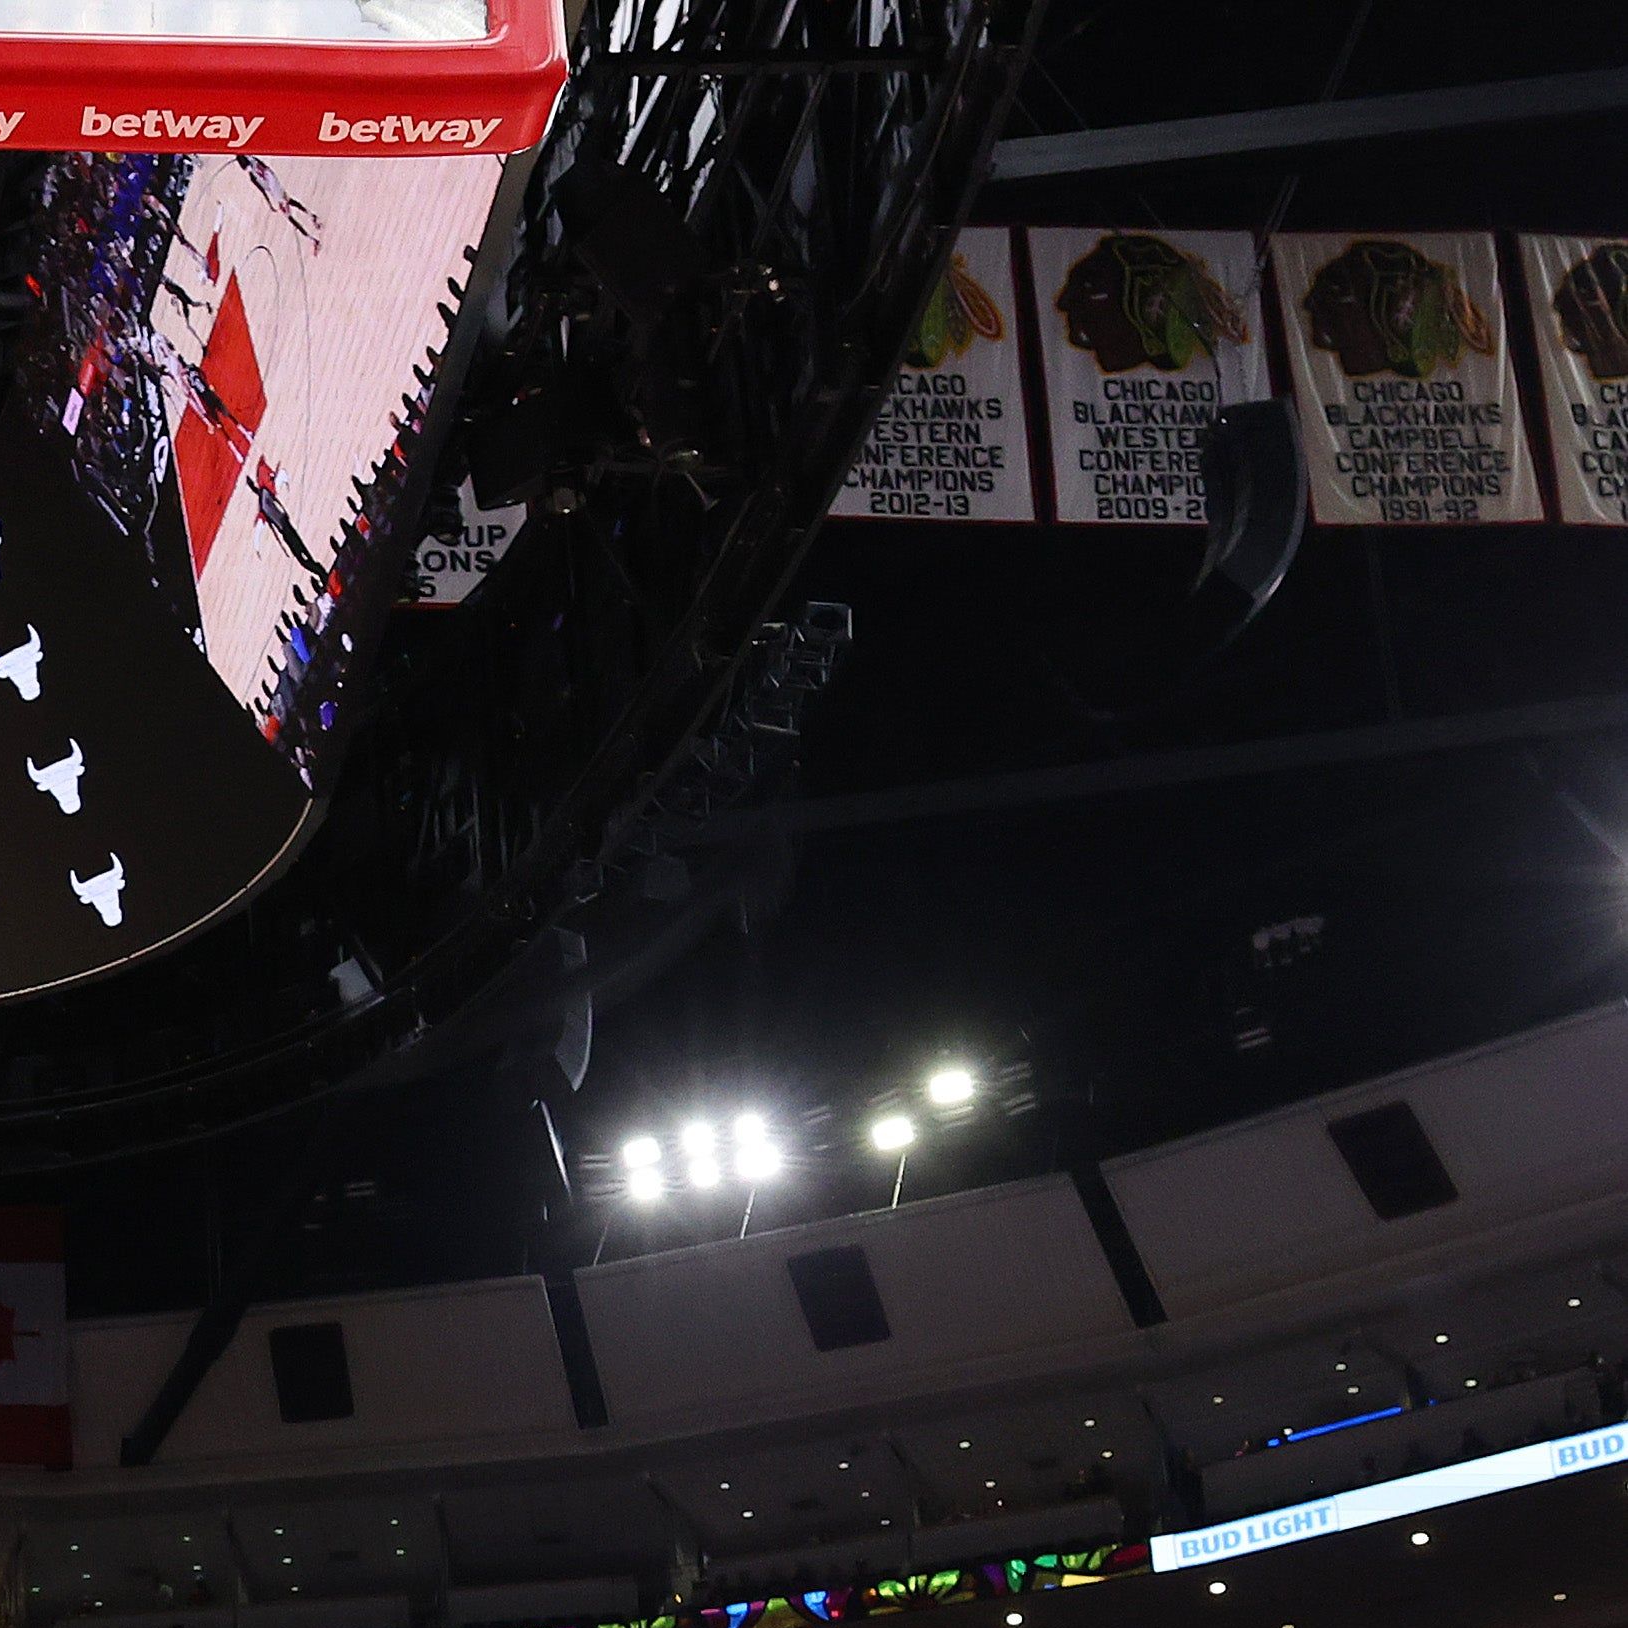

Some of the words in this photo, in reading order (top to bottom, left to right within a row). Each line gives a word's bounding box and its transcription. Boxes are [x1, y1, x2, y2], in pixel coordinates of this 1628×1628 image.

[80, 106, 264, 148] betway
[318, 112, 502, 149] betway
[1104, 380, 1215, 402] CHICAGO
[1354, 381, 1462, 402] CHICAGO
[1326, 404, 1501, 427] BLACKHAWKS
[1349, 428, 1492, 450] CAMPBELL
[1337, 451, 1510, 474] CONFERENCE
[1352, 474, 1501, 498] CHAMPIONS
[871, 492, 969, 516] 2012-13
[1558, 1429, 1627, 1470] BUD
[1180, 1526, 1242, 1560] BUD
[1246, 1506, 1333, 1548] LIGHT
